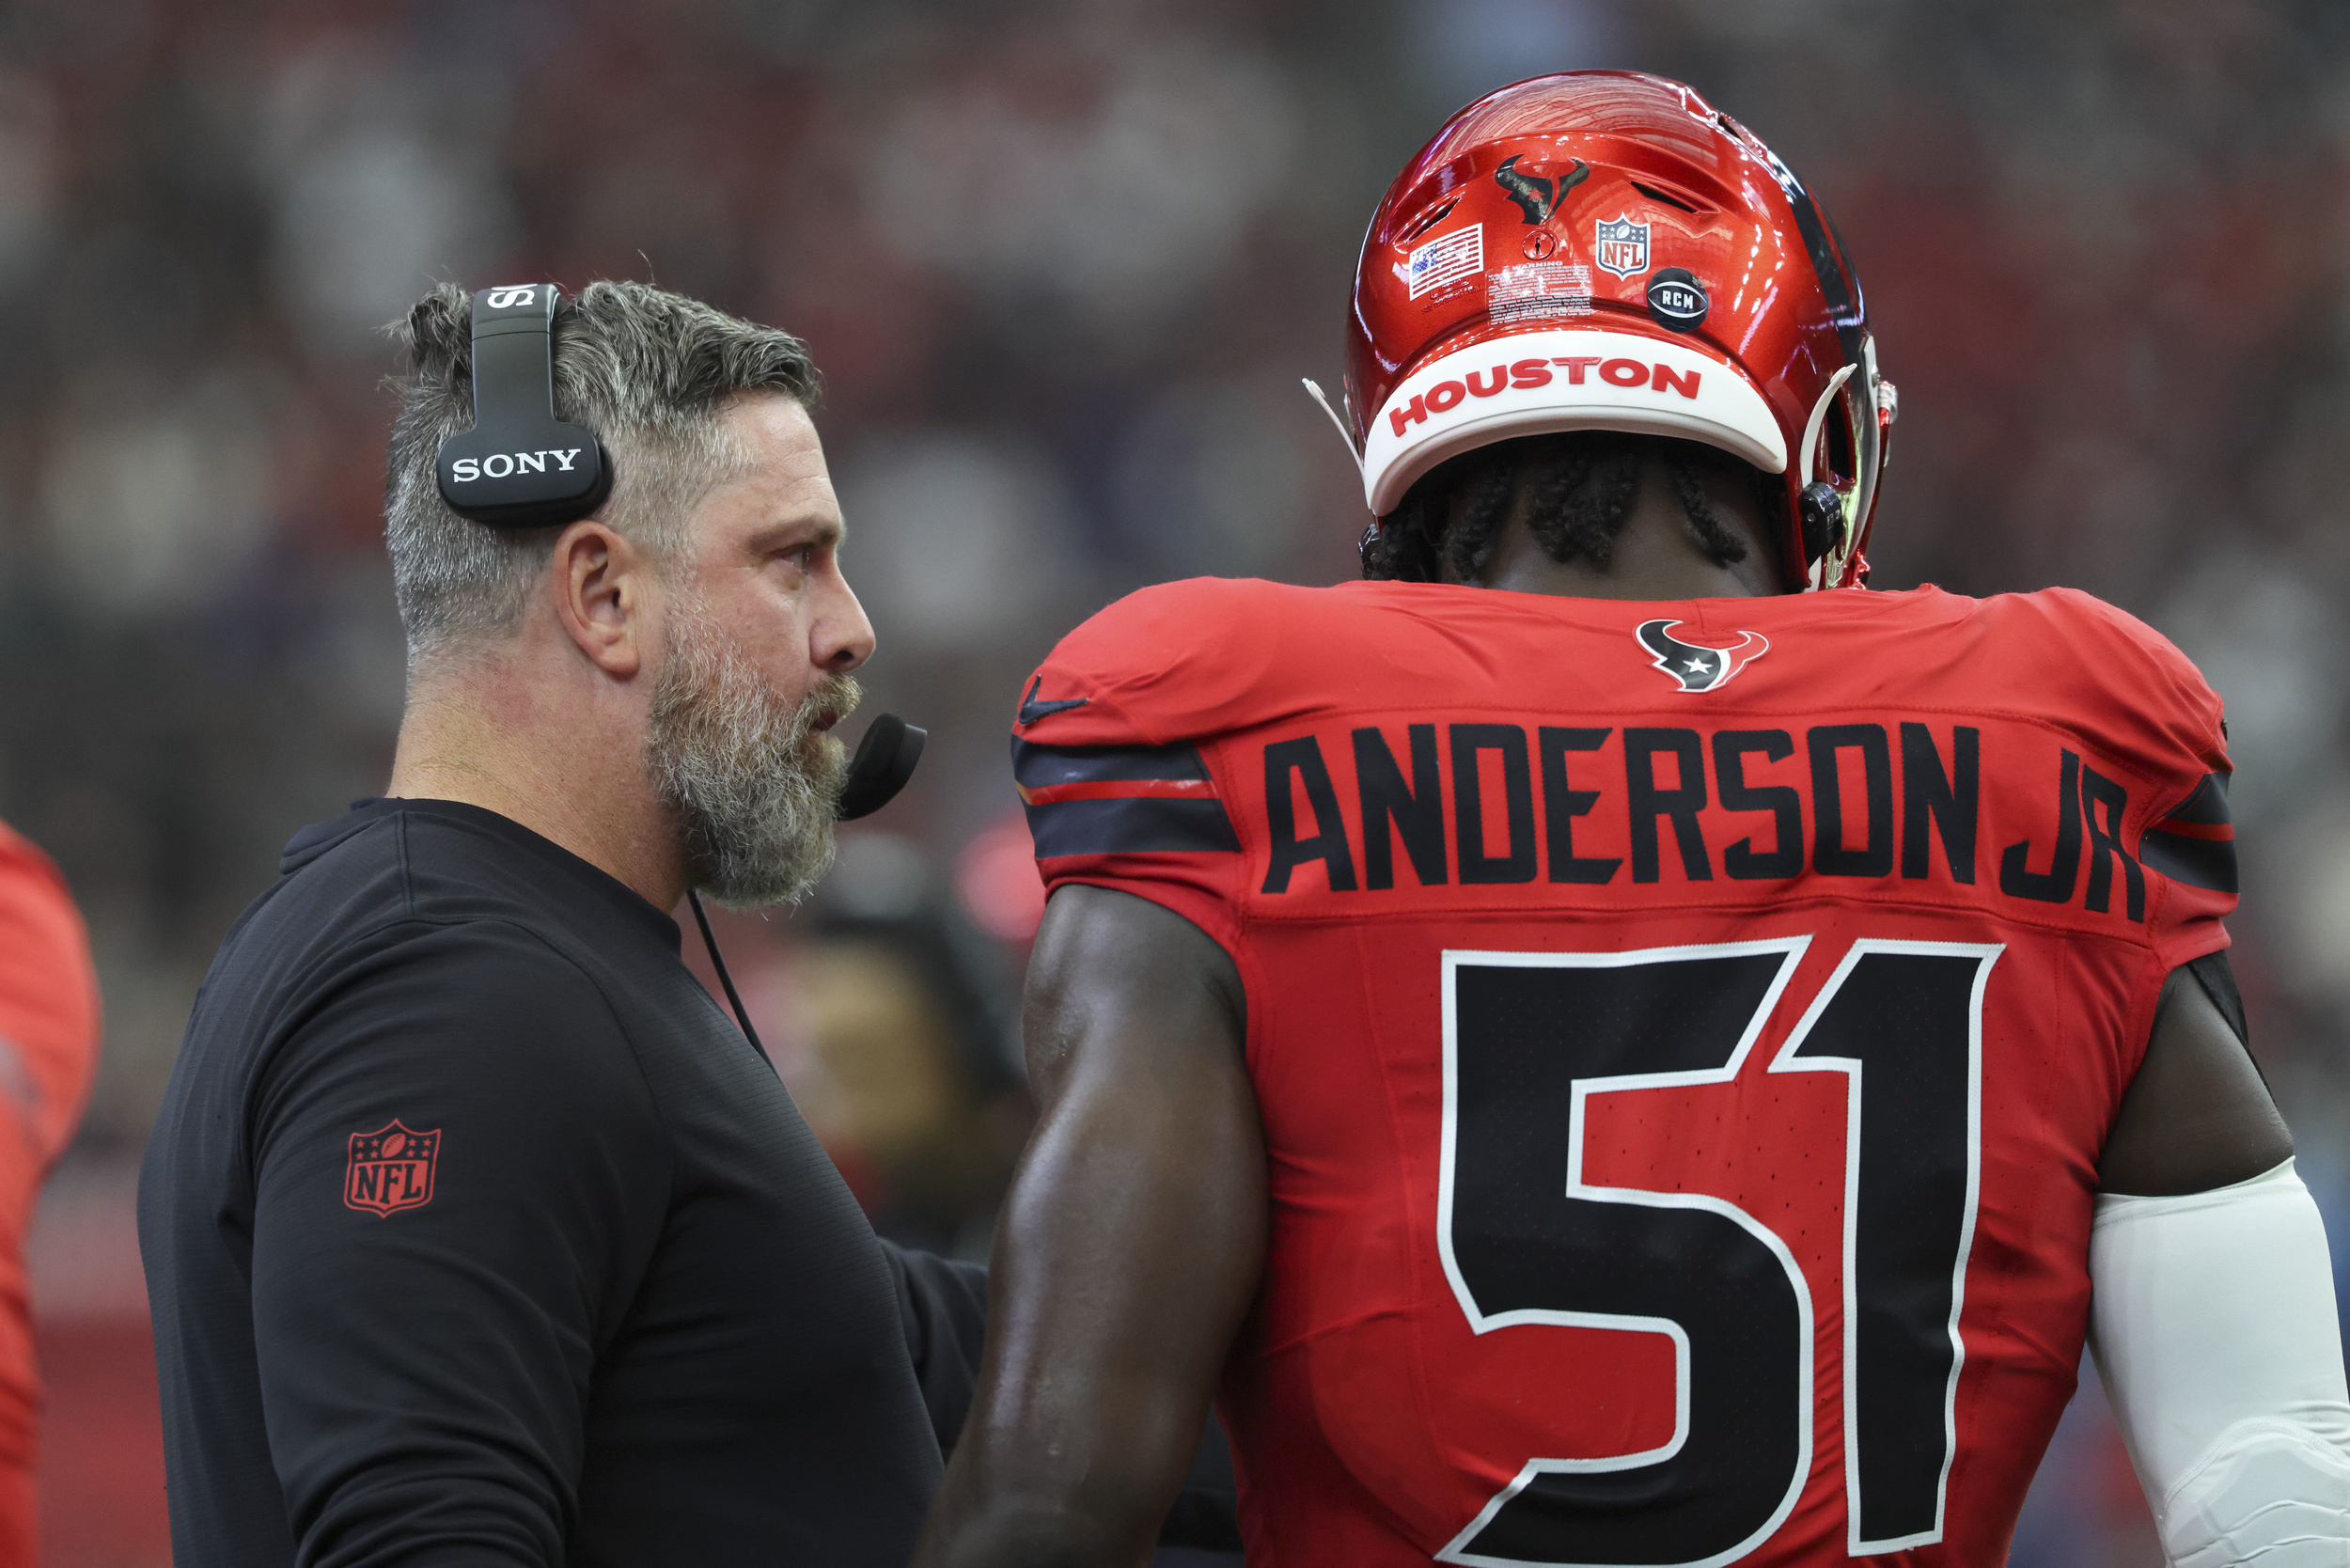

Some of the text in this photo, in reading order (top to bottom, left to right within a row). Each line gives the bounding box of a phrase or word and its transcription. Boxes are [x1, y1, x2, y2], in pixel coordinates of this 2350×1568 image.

[1512, 261, 1563, 271] WARNING
[1603, 242, 1643, 270] NFL
[1662, 290, 1694, 309] RCM
[1388, 356, 1701, 437] HOUSTON
[452, 448, 582, 483] SONY
[1261, 722, 2146, 923] ANDERSON JR
[353, 1163, 423, 1205] NFL
[1434, 933, 2007, 1567] 51
